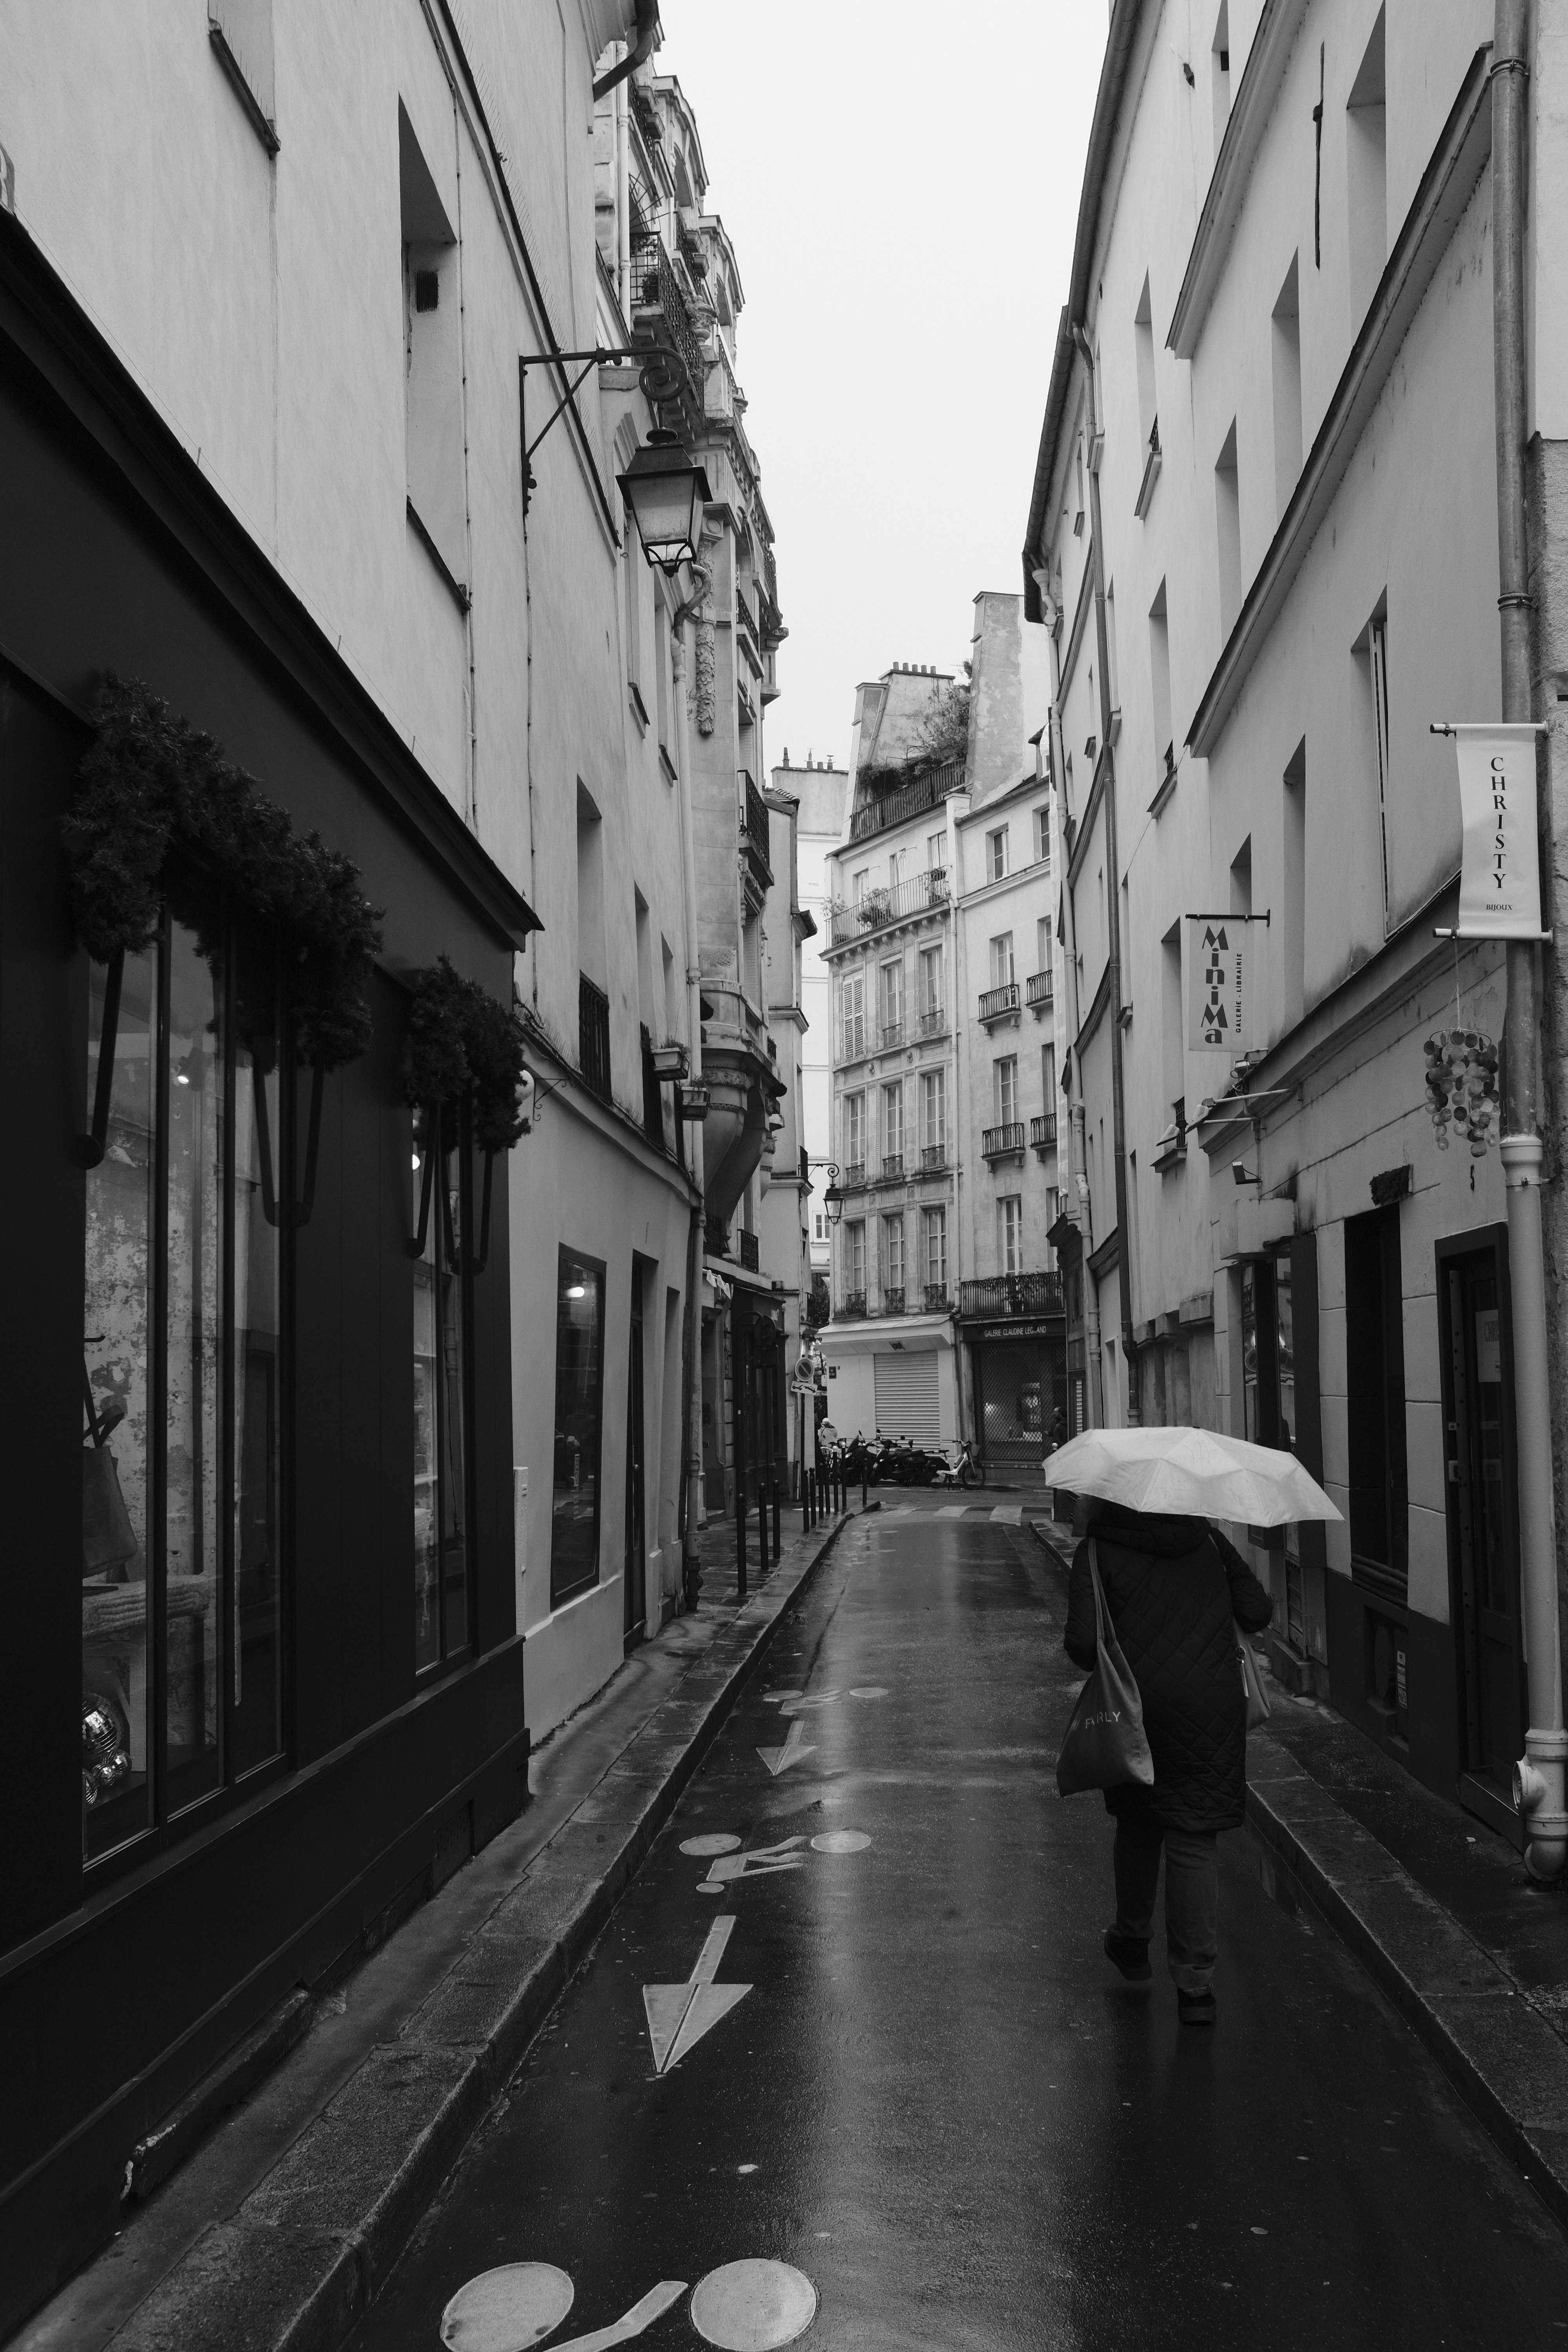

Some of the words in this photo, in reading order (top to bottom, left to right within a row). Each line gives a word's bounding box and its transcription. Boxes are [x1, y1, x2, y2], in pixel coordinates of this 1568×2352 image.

[1490, 757, 1507, 888] CHRISTY
[1470, 1165, 1474, 1190] 5
[1003, 1327, 1024, 1336] CLAUDINE
